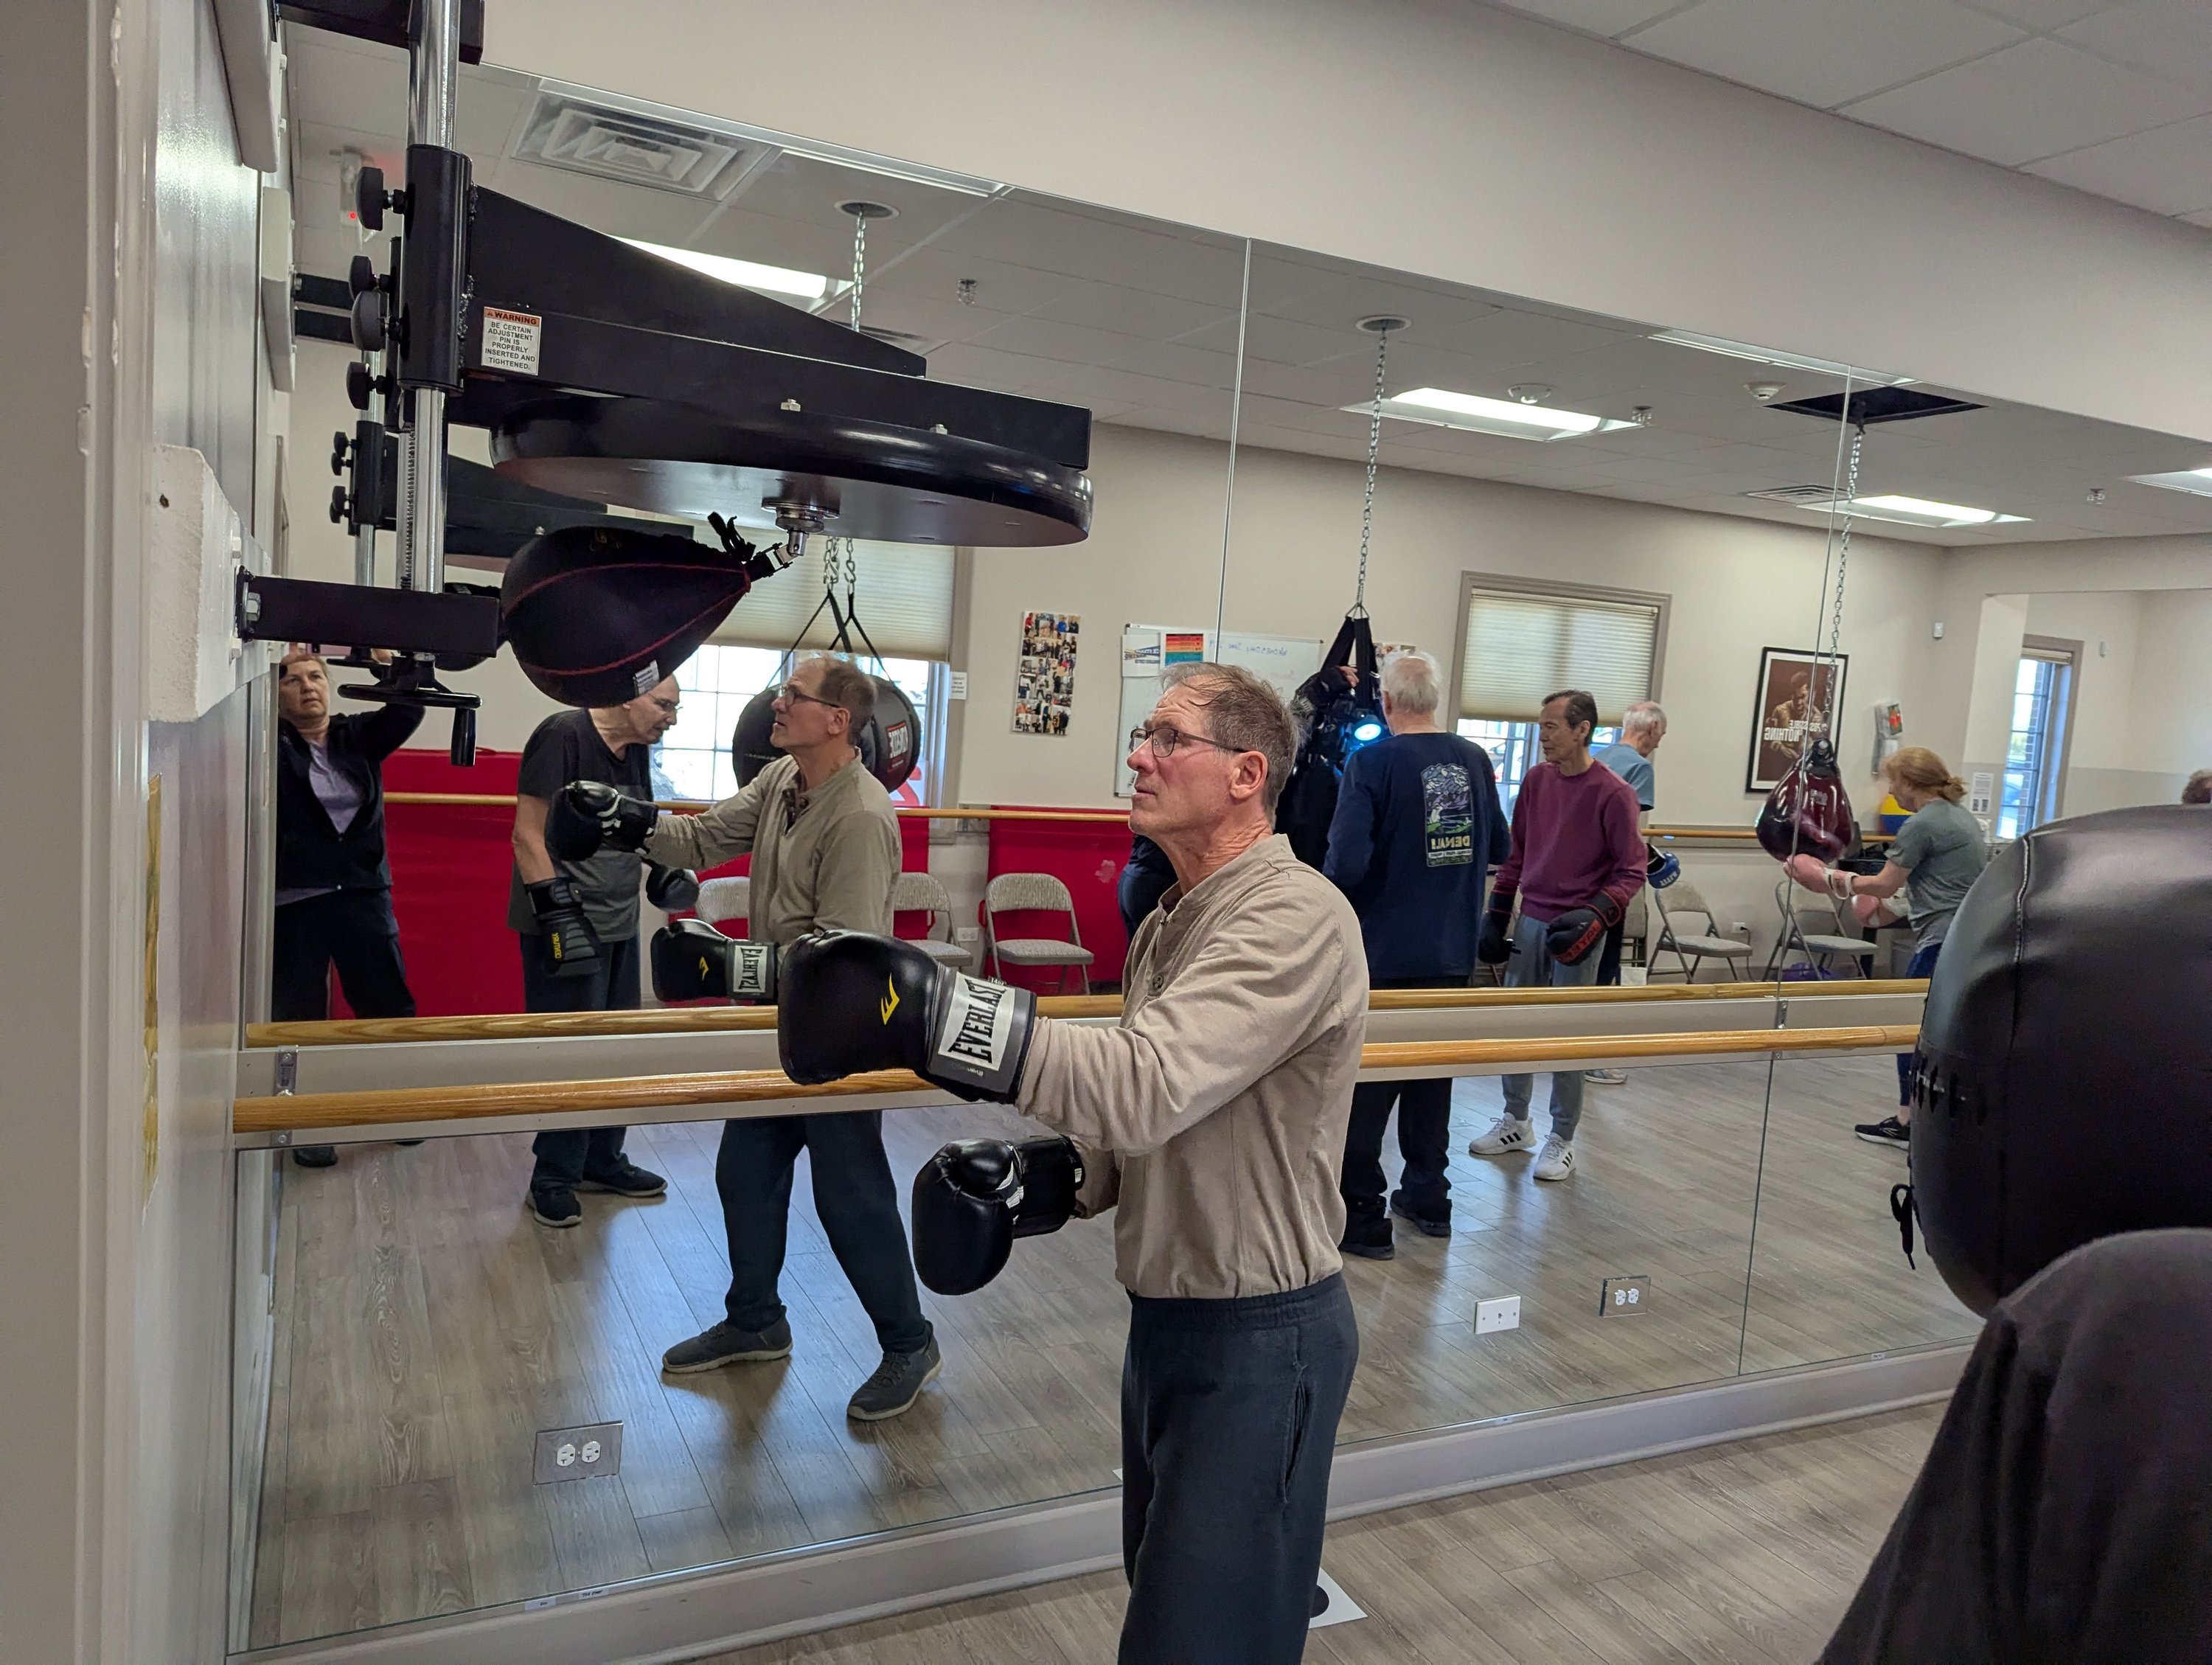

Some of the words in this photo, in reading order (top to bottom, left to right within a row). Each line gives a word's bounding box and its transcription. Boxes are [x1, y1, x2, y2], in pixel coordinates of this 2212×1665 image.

[495, 312, 537, 325] WARNING
[488, 328, 533, 341] ADJUSTMENT
[503, 324, 532, 334] CERTAIN
[484, 348, 519, 359] INSERTED
[492, 342, 529, 353] PROPERLY
[947, 978, 1008, 1063] EVERLAST
